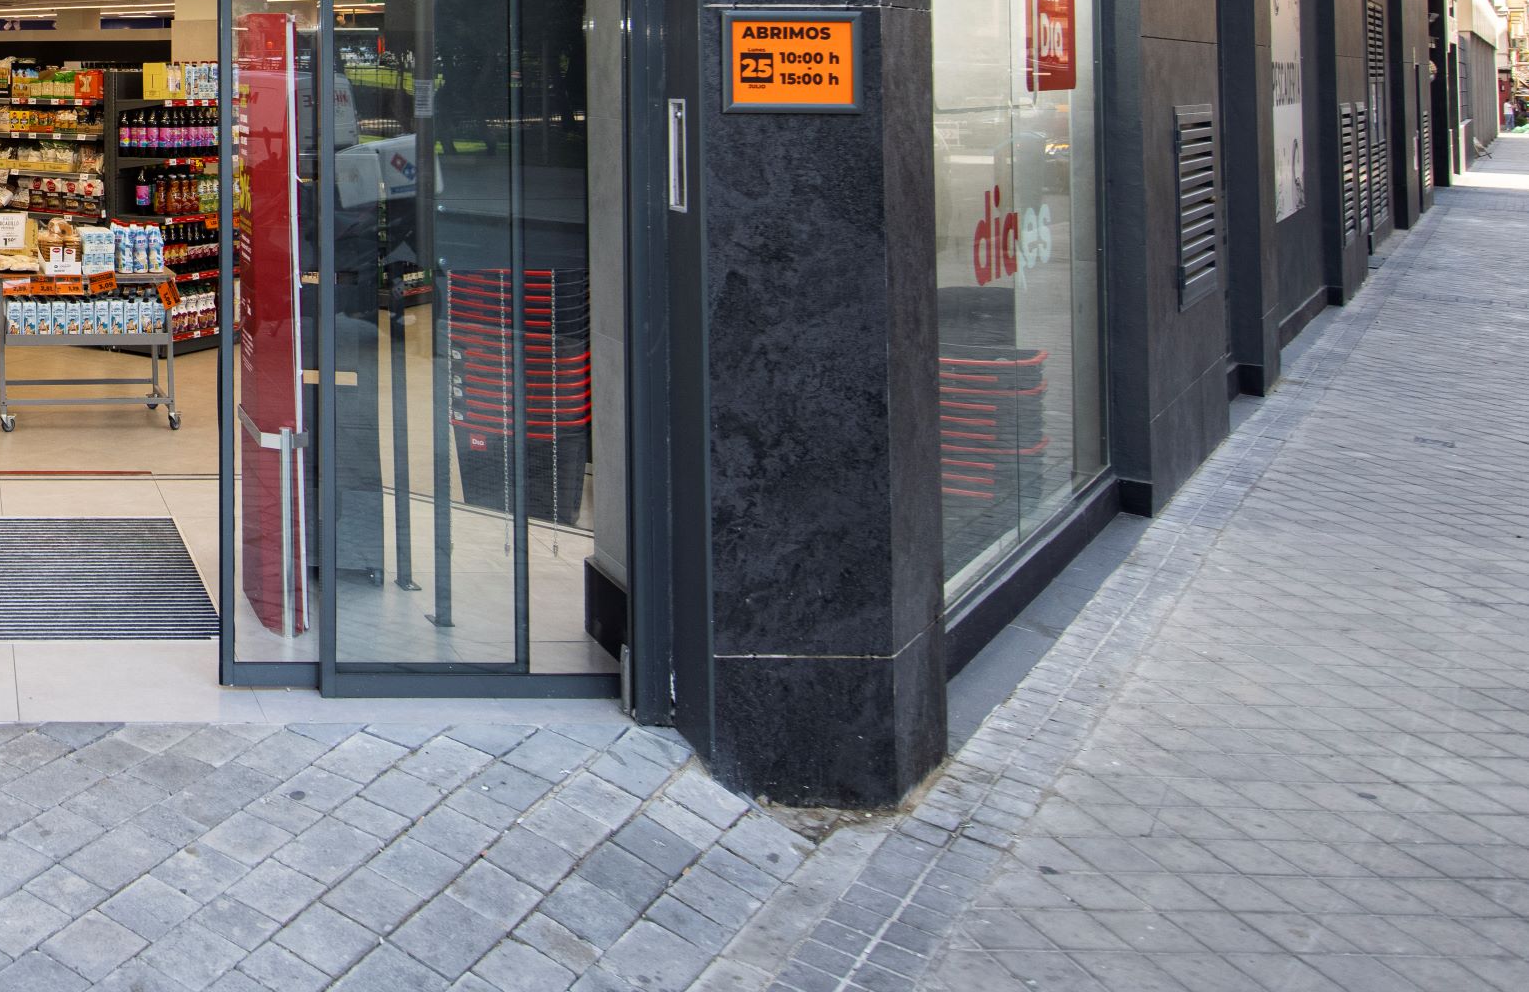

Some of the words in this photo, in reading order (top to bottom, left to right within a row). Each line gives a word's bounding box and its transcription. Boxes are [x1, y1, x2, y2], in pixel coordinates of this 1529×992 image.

[742, 26, 831, 40] ABRIMOS
[1040, 12, 1063, 60] Dia
[779, 52, 824, 64] 10:00
[829, 52, 840, 65] h
[741, 58, 773, 78] 25
[779, 73, 823, 85] 15:00
[828, 73, 839, 85] h
